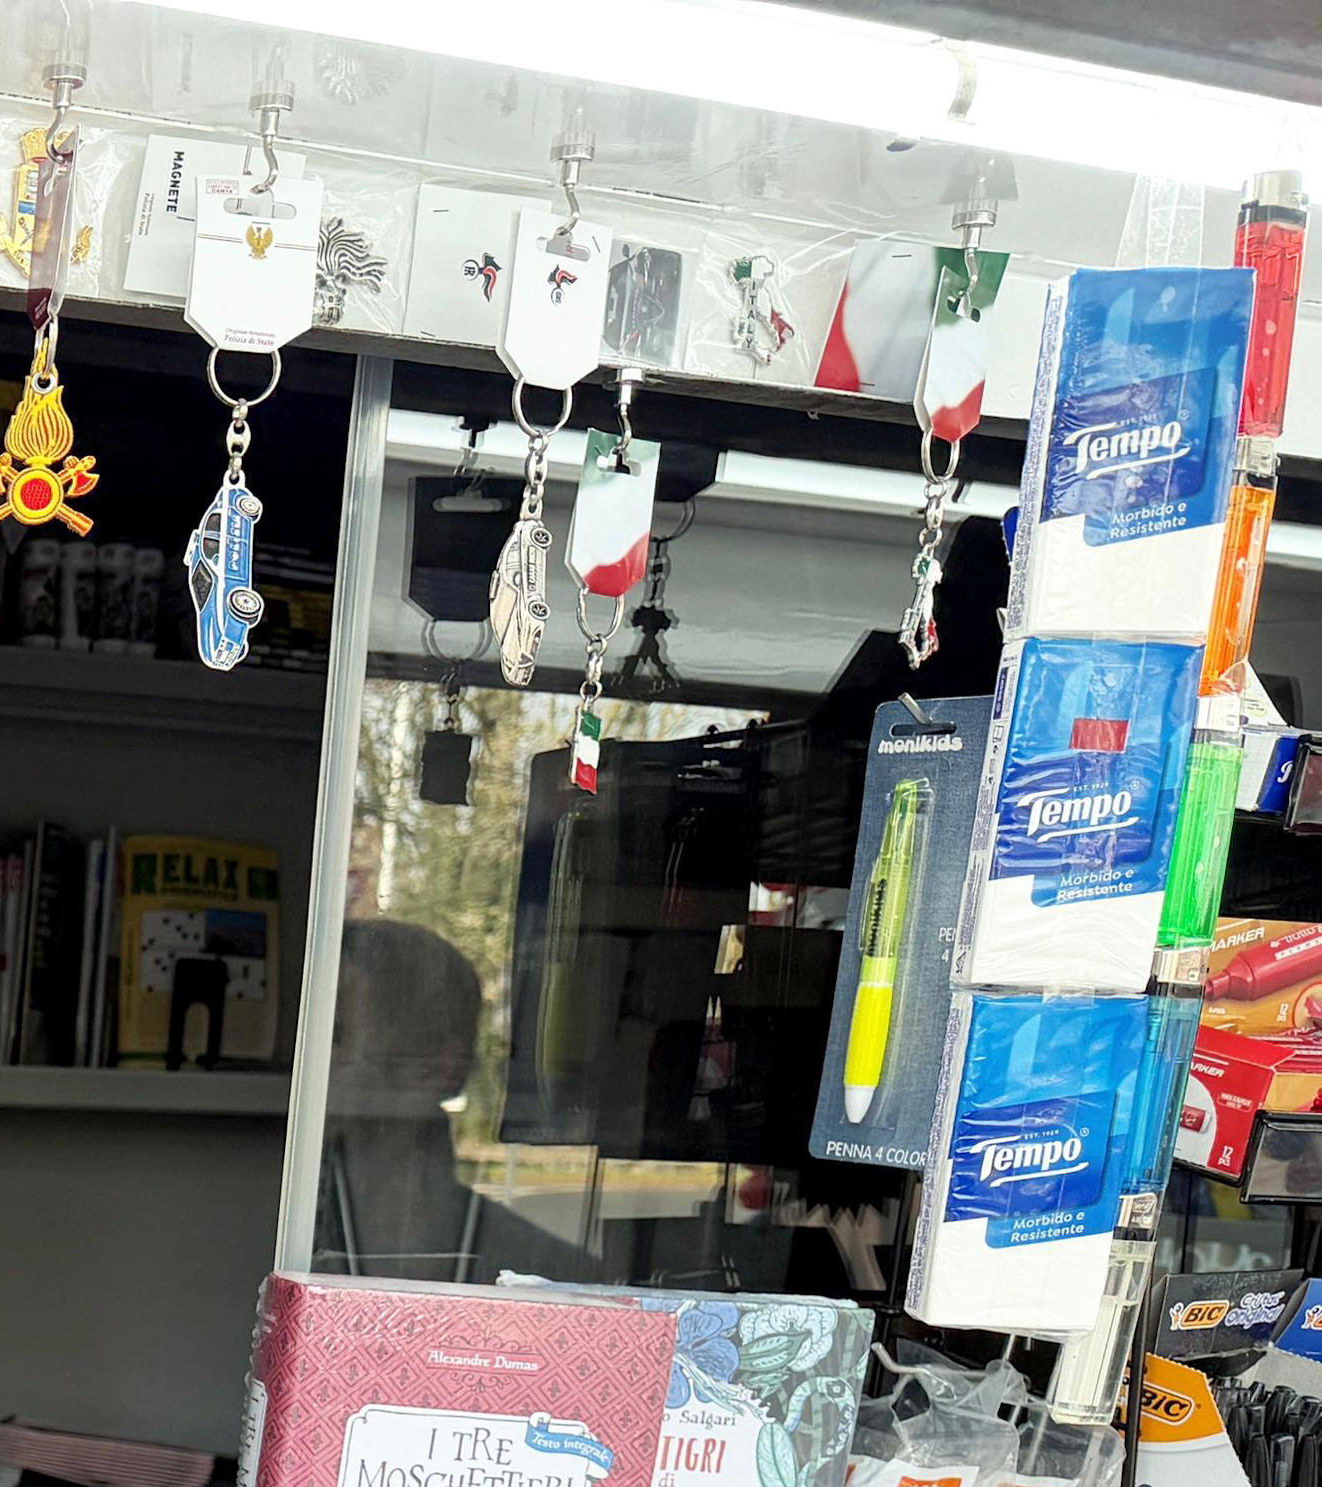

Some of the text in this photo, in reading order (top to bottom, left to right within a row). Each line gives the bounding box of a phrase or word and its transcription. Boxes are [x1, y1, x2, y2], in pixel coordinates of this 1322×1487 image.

[166, 151, 184, 213] MAGNETE
[745, 278, 757, 349] ITALY
[1063, 421, 1181, 473] Tempo
[1112, 503, 1187, 524] Morbido e
[1110, 516, 1186, 539] Resistente
[878, 735, 962, 753] monikids
[1017, 787, 1132, 837] Tempo
[1060, 869, 1134, 887] Morbido e
[1057, 880, 1132, 901] Resistente
[826, 1142, 872, 1159] PENNA
[875, 1146, 883, 1160] 4
[969, 1135, 1082, 1182] Tempo
[1014, 1211, 1084, 1229] Morbido e
[1011, 1223, 1084, 1242] Resistente
[1184, 1304, 1225, 1322] BIC
[428, 1350, 539, 1371] Alexandre Dumas
[680, 1411, 736, 1429] Salgari
[429, 1428, 513, 1466] I TRE
[532, 1431, 610, 1463] Testo integrale
